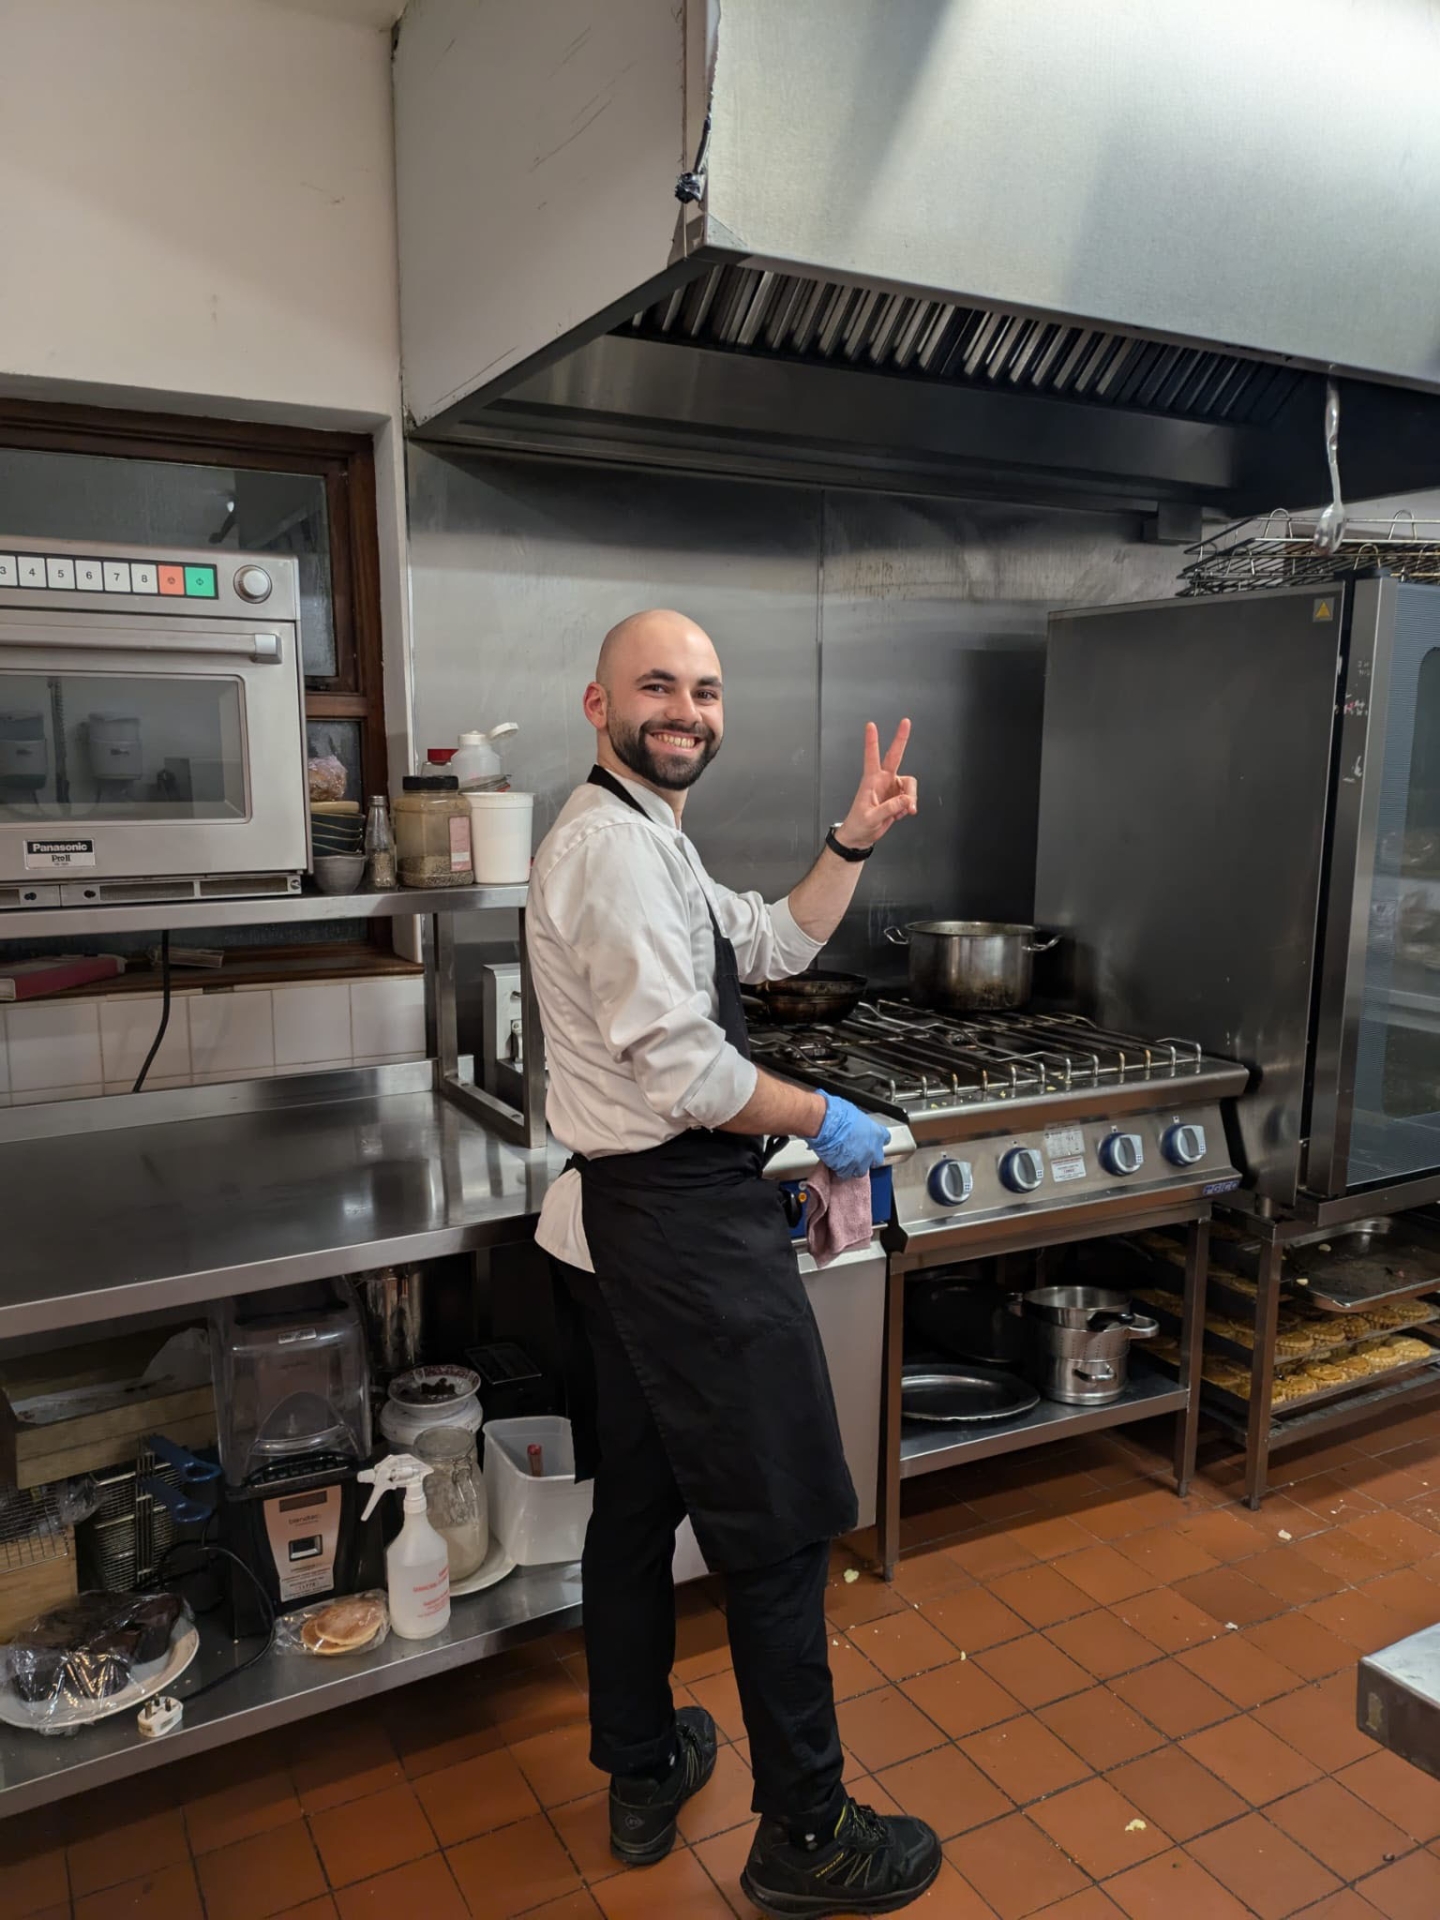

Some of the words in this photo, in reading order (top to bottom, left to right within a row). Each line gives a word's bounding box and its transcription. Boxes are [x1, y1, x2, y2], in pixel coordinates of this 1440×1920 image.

[0, 565, 7, 575] 3
[28, 567, 36, 577] 4
[57, 569, 65, 579] 5
[85, 571, 93, 580] 6
[113, 572, 121, 582] 7
[140, 574, 148, 583] 8
[33, 842, 88, 852] Panasonic
